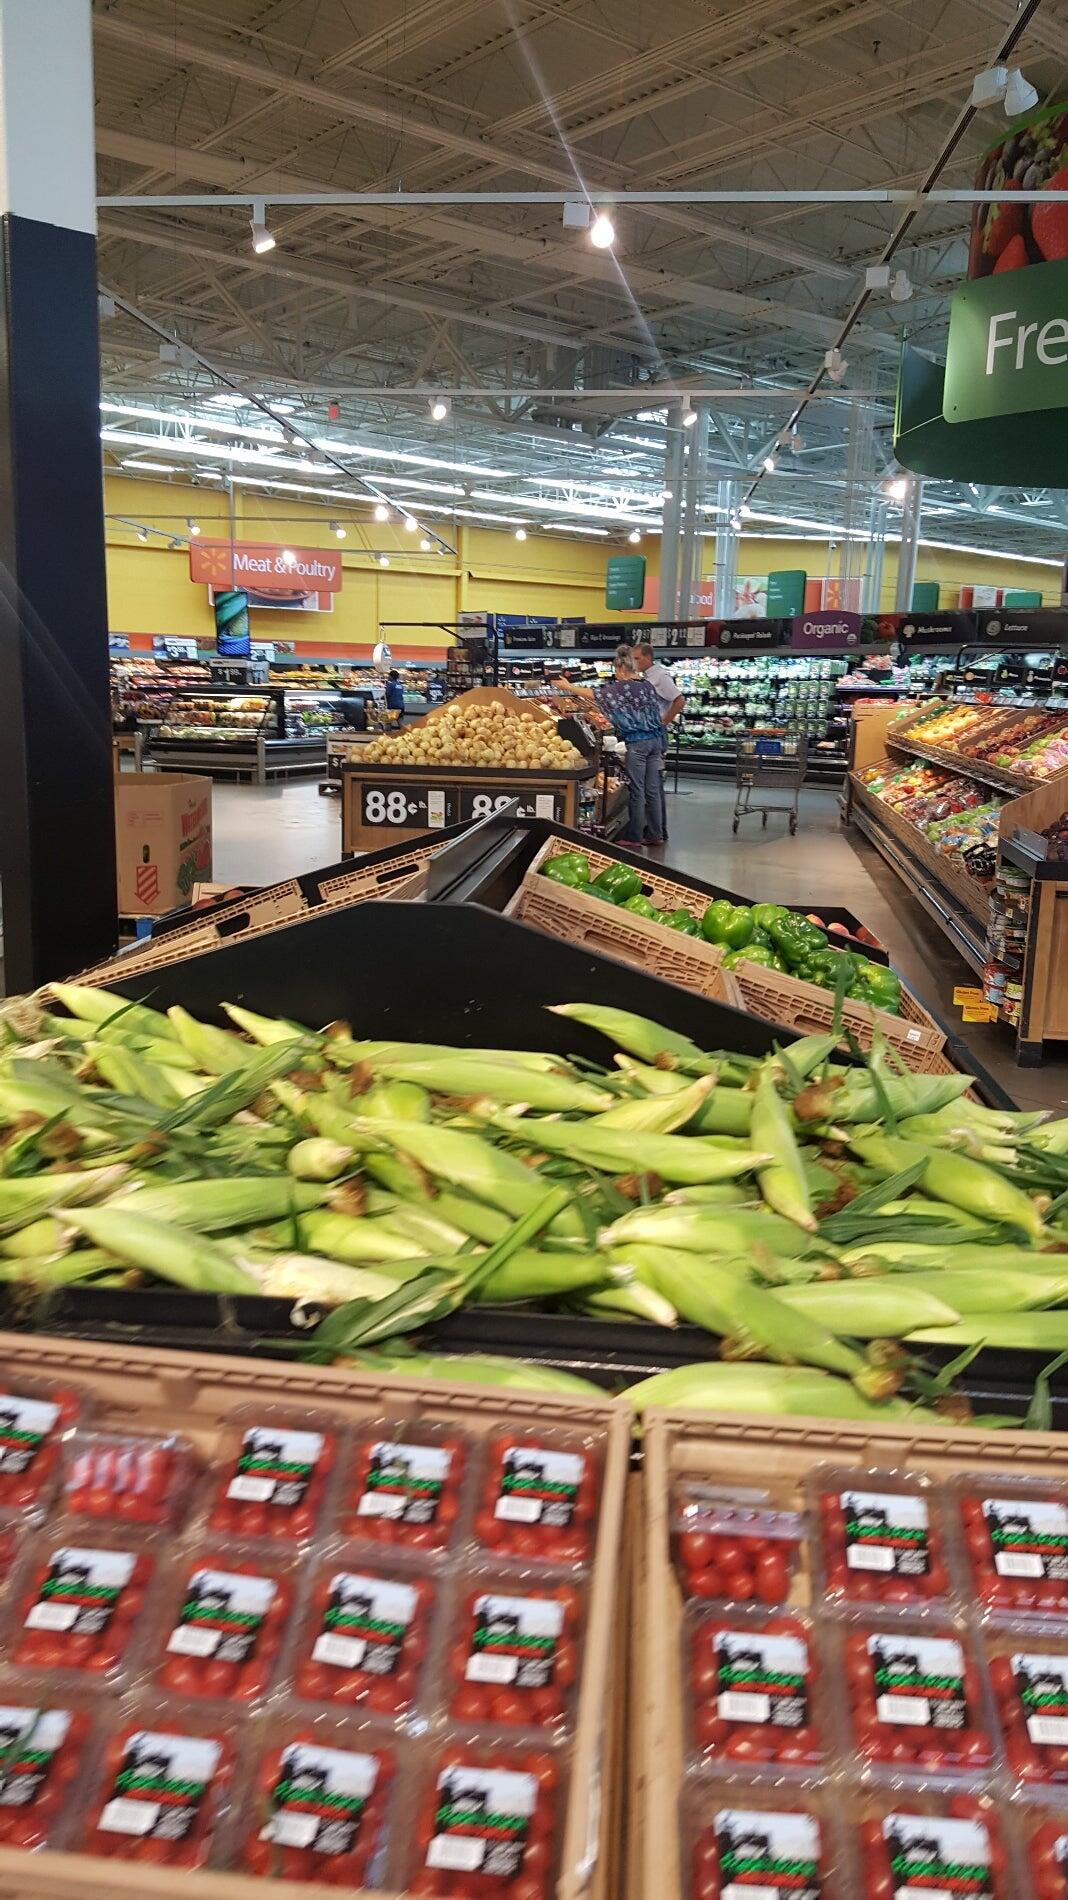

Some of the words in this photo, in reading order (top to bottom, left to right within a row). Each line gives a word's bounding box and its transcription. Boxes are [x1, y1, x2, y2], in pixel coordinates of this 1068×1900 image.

[986, 311, 1068, 375] Fre
[233, 553, 272, 573] Meat
[274, 557, 286, 575] &
[287, 559, 336, 582] Poultry
[789, 607, 796, 616] 2
[803, 621, 849, 638] Organic
[1004, 623, 1028, 632] Lettuce
